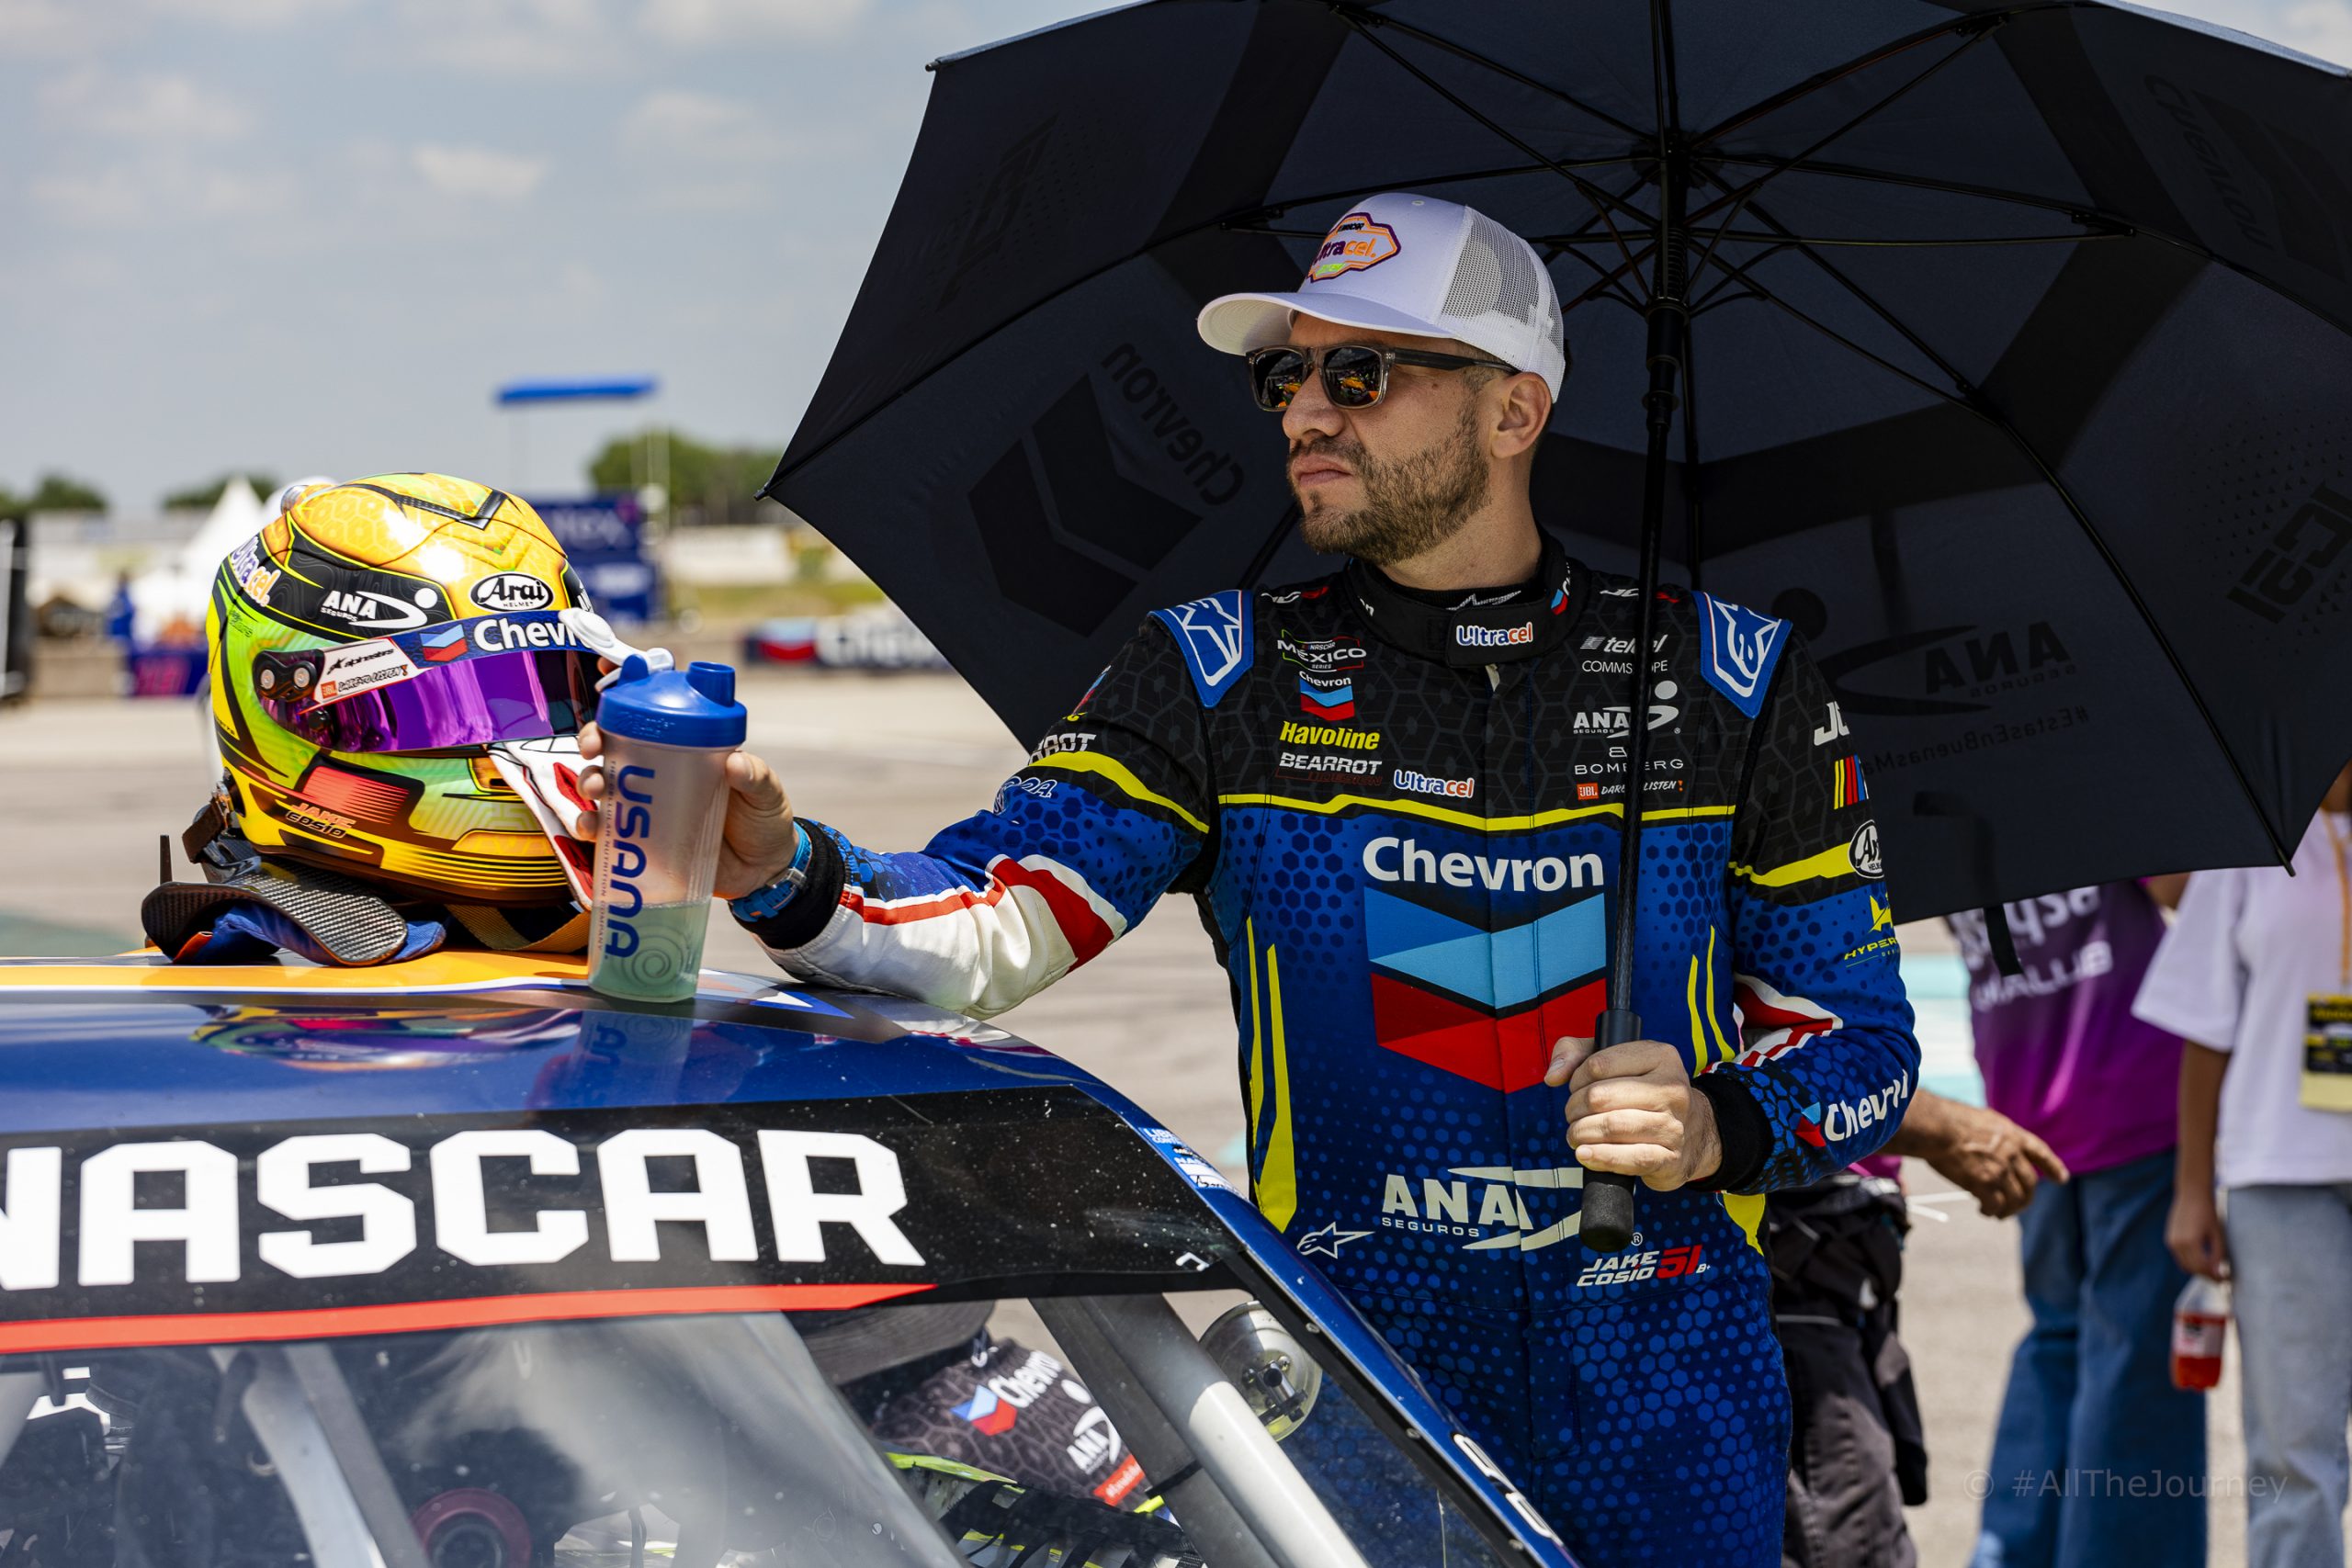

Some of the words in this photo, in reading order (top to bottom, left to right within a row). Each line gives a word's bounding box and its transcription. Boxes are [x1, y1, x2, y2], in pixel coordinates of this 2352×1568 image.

[478, 576, 546, 604] Arai
[322, 591, 378, 620] ANA
[473, 617, 593, 653] Chevr
[1309, 641, 1336, 650] NASCAR
[1456, 622, 1533, 647] Ultracel
[1603, 634, 1668, 654] tell
[1277, 639, 1367, 663] MEXICO
[1298, 671, 1351, 687] Chevron
[1582, 660, 1668, 674] COMMSPE
[1574, 712, 1630, 728] ANA
[1279, 720, 1381, 750] Havoline
[1278, 751, 1383, 775] BEARROT
[1393, 769, 1475, 798] Ultracel
[1579, 785, 1598, 798] JBL
[291, 802, 356, 829] JAKE
[605, 764, 656, 959] USANA
[1363, 836, 1604, 892] Chevron
[1381, 1173, 1533, 1230] ANA
[1381, 1217, 1479, 1237] SEGUROS
[1582, 1250, 1660, 1272] JAKE
[1657, 1244, 1703, 1280] 51
